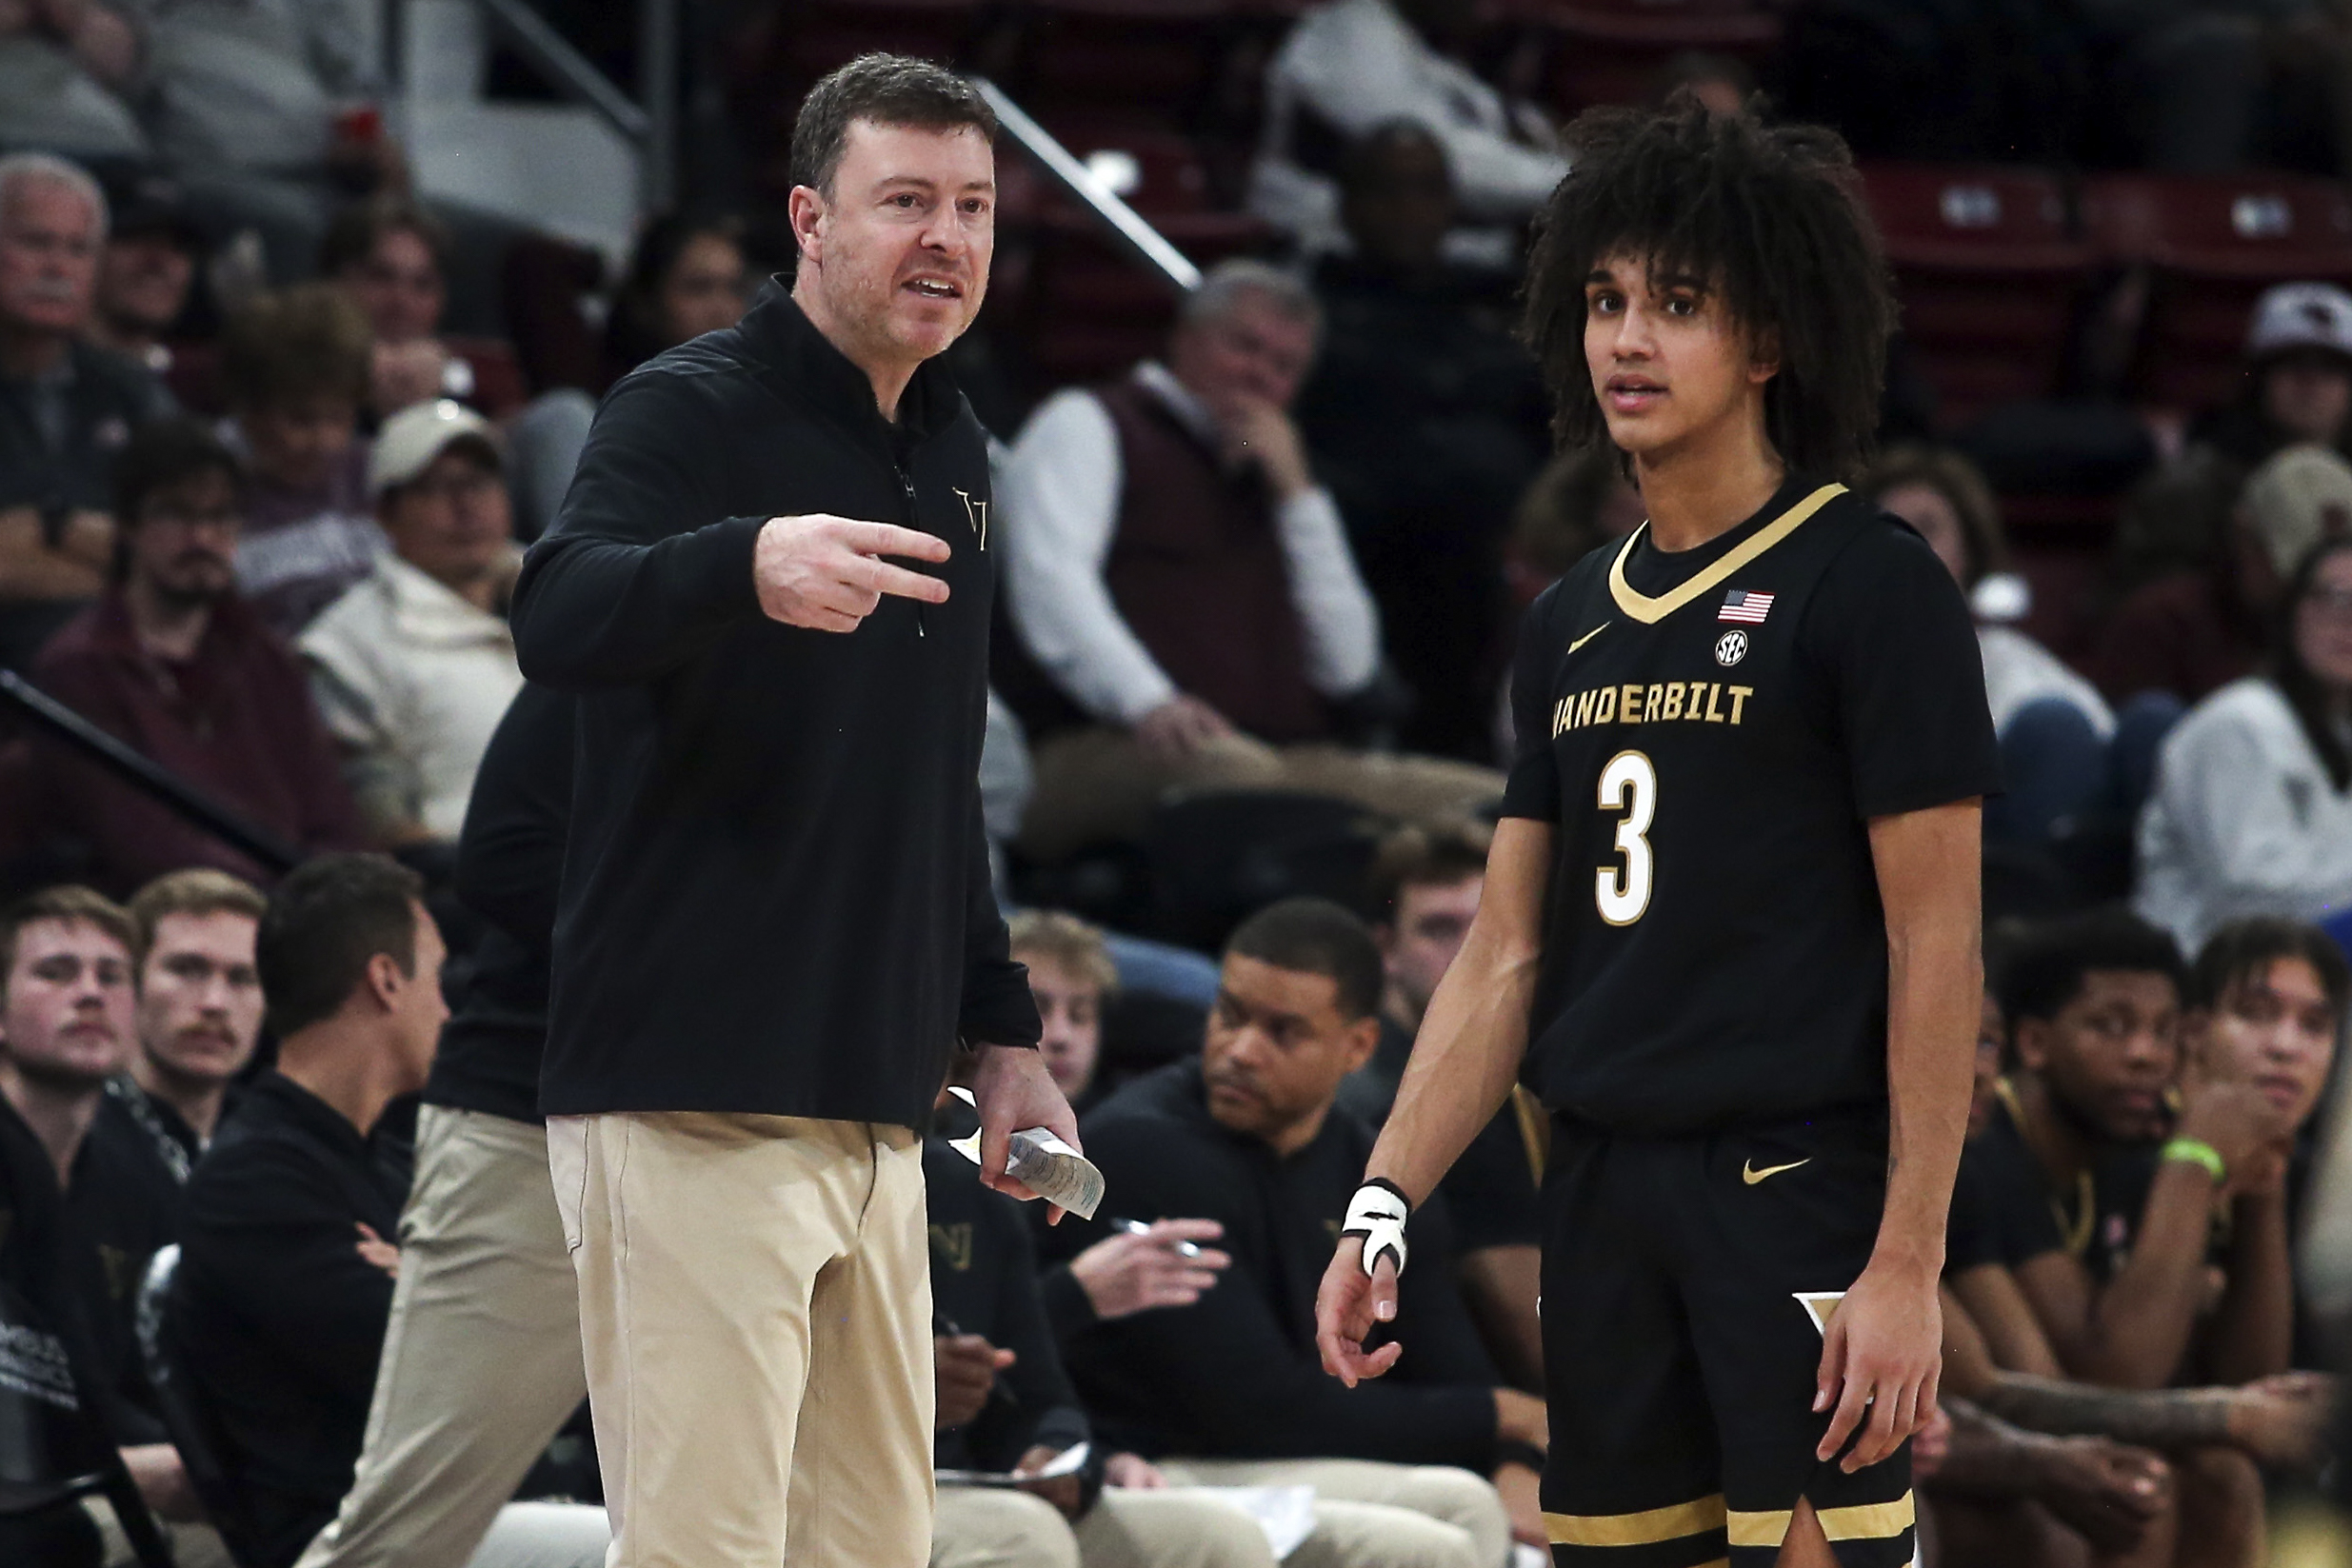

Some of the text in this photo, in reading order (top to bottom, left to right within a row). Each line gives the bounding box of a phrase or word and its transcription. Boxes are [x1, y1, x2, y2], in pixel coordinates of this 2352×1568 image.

[1717, 632, 1745, 664] SEC
[1552, 681, 1754, 740] VANDERBILT
[1595, 749, 1657, 926] 3
